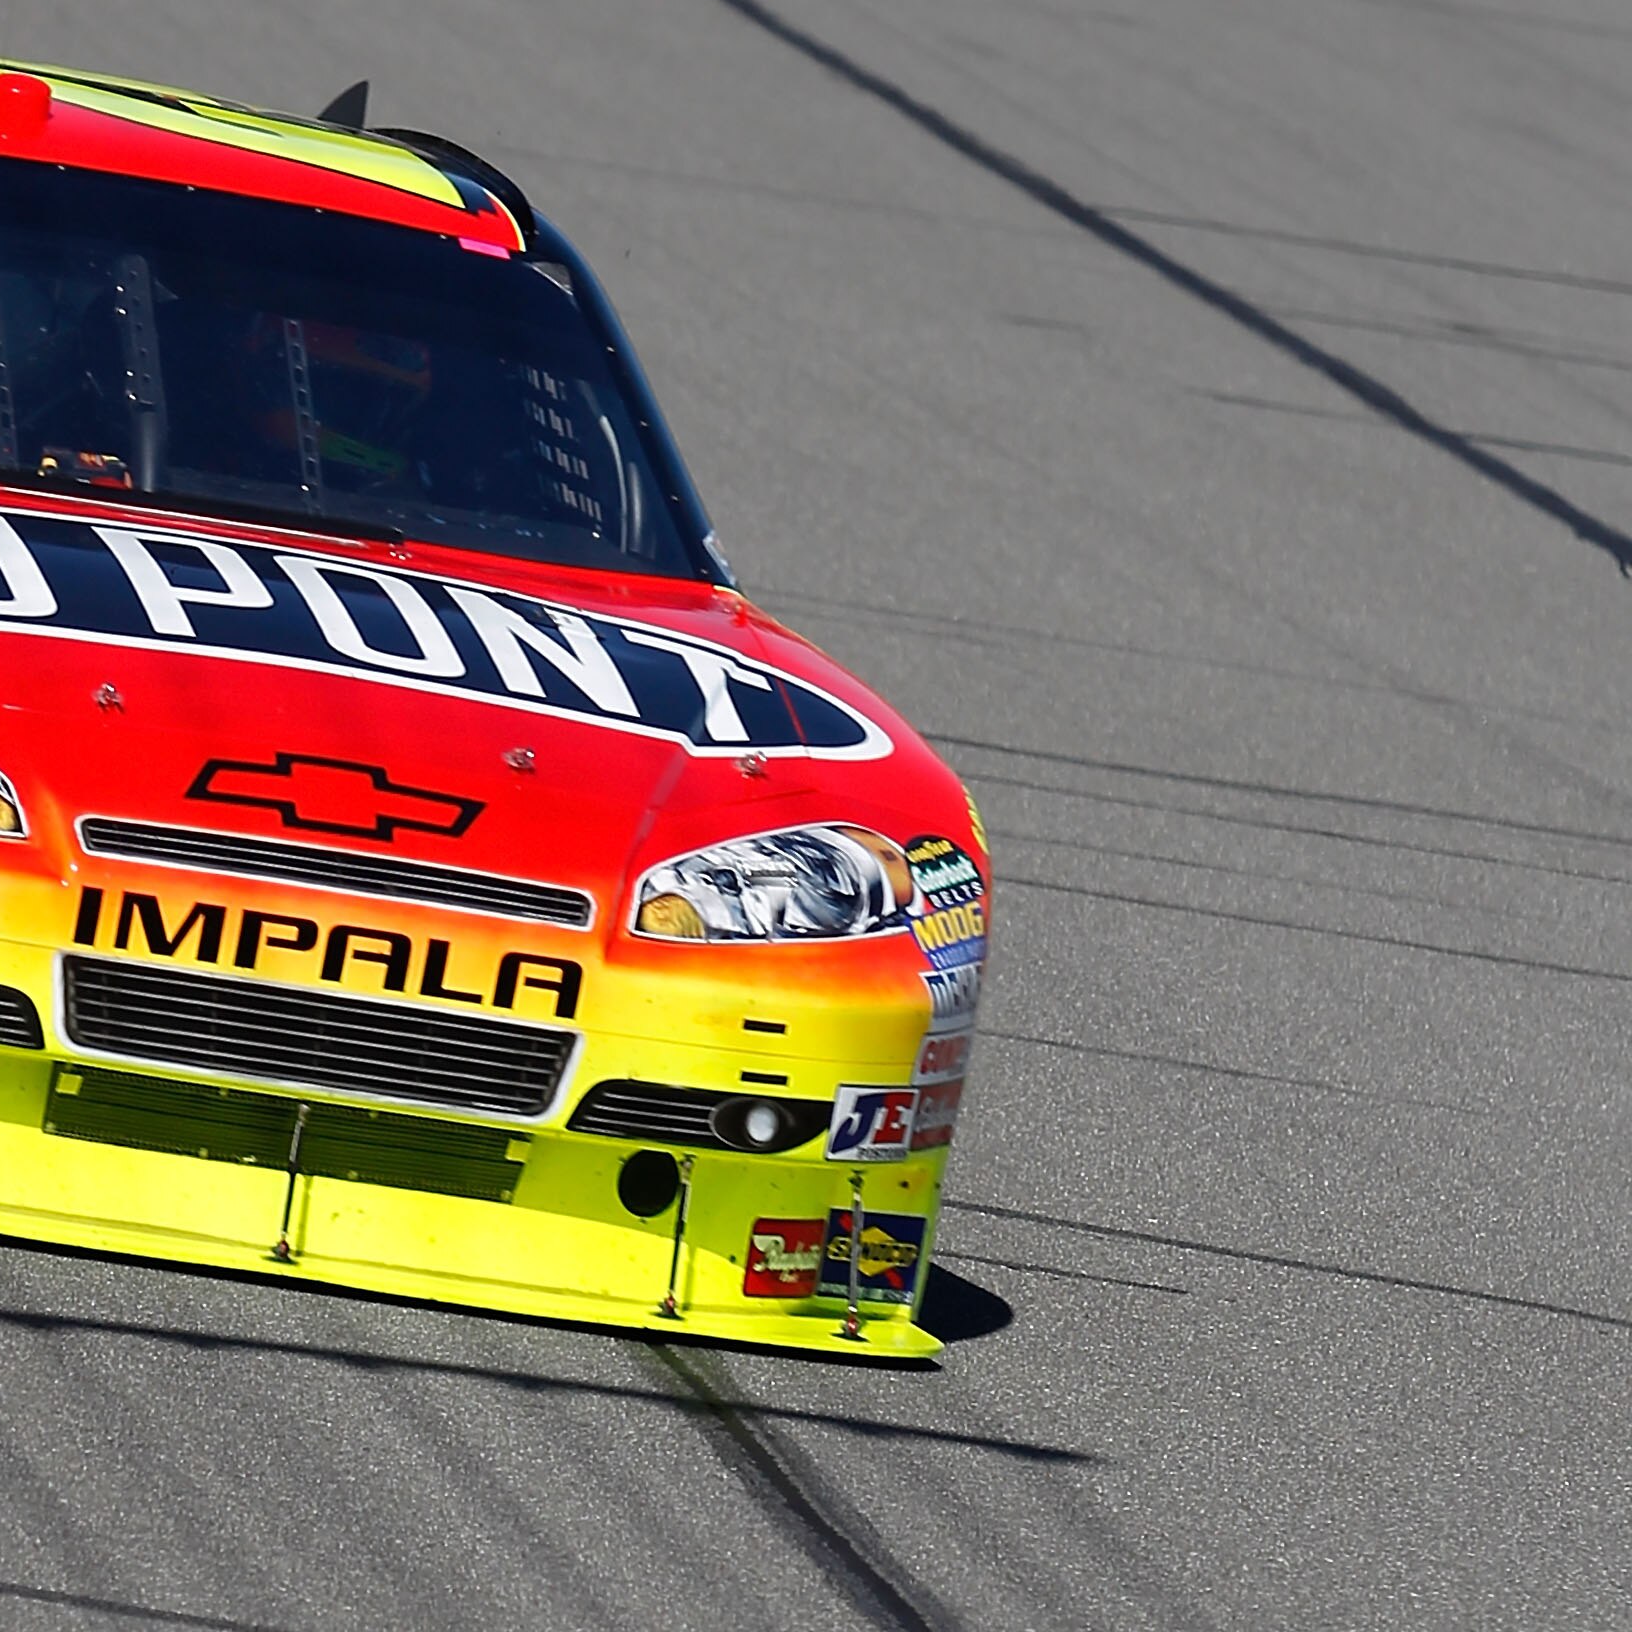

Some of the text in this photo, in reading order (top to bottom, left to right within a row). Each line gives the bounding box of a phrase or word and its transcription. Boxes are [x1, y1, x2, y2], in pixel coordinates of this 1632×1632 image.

[928, 880, 987, 909] BELTS
[74, 886, 583, 1020] IMPALA
[911, 900, 984, 954] MOOG
[830, 1091, 915, 1155] JE
